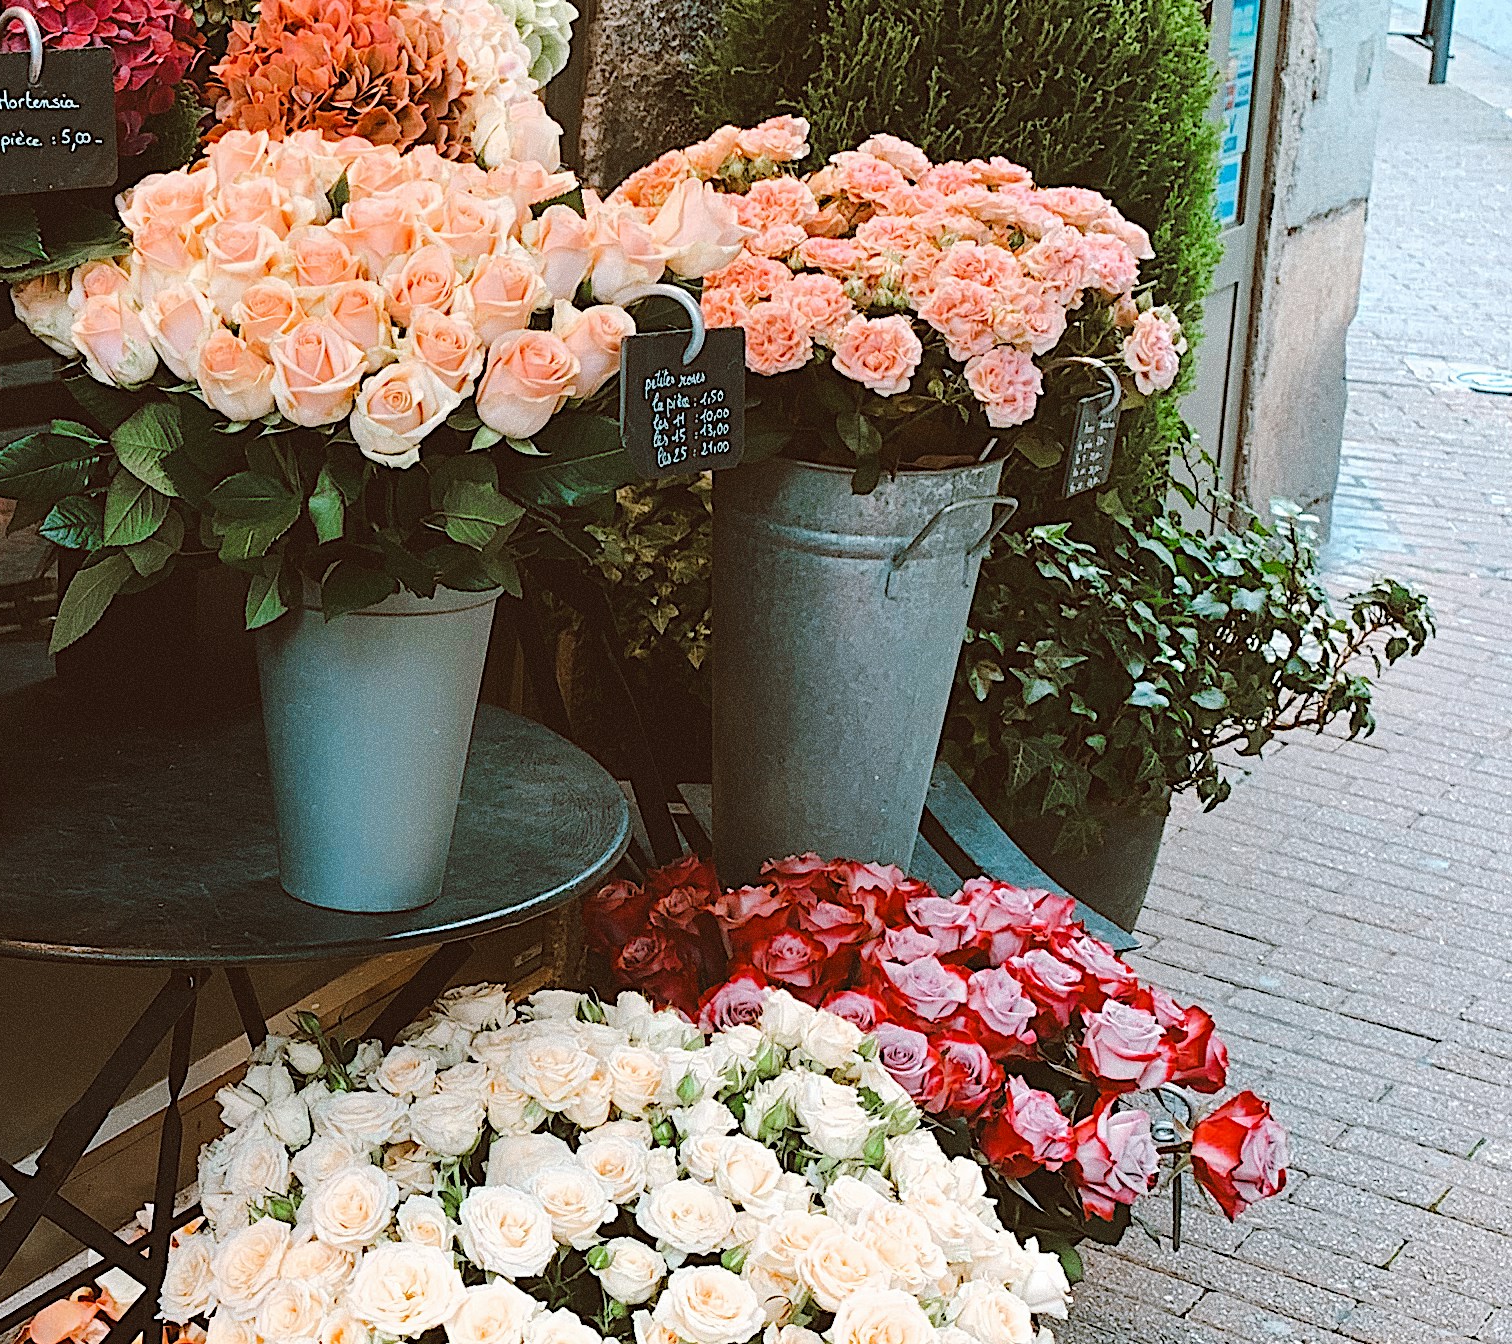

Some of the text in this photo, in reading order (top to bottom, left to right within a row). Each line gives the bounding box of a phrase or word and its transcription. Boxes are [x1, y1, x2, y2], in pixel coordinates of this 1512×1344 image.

[0, 131, 43, 154] pièce
[644, 369, 706, 400] petites roses
[652, 392, 664, 412] la
[699, 390, 724, 405] 1,50
[653, 414, 669, 430] les
[673, 412, 685, 427] 11
[700, 408, 729, 423] 10,00
[653, 430, 669, 448] les
[672, 428, 686, 443] 15
[699, 422, 729, 438] 13,00
[657, 447, 671, 467] les
[673, 446, 688, 463] 25
[701, 441, 730, 456] 21,00
